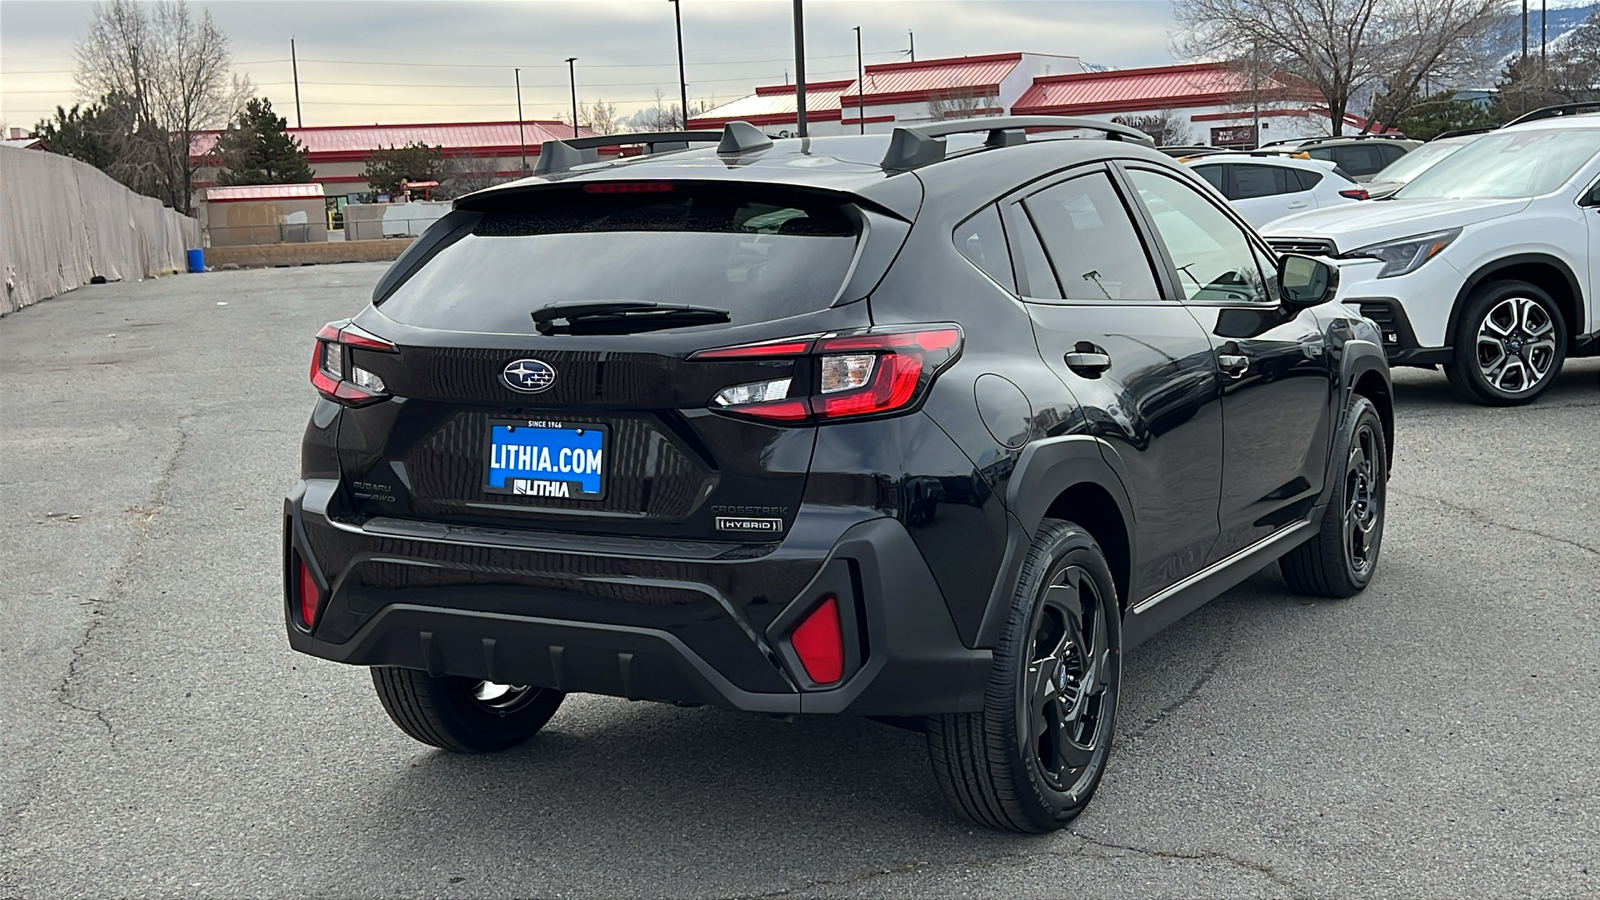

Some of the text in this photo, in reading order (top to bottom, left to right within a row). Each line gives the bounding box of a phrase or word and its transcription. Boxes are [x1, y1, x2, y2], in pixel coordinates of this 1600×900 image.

[528, 420, 562, 429] SINCE 1946
[490, 443, 603, 475] LITHIA.COM
[353, 481, 392, 492] SUBARU
[526, 480, 570, 498] LITHIA
[370, 494, 397, 503] AWD
[711, 504, 788, 515] CROSSTREK
[726, 521, 771, 529] HYBRID
